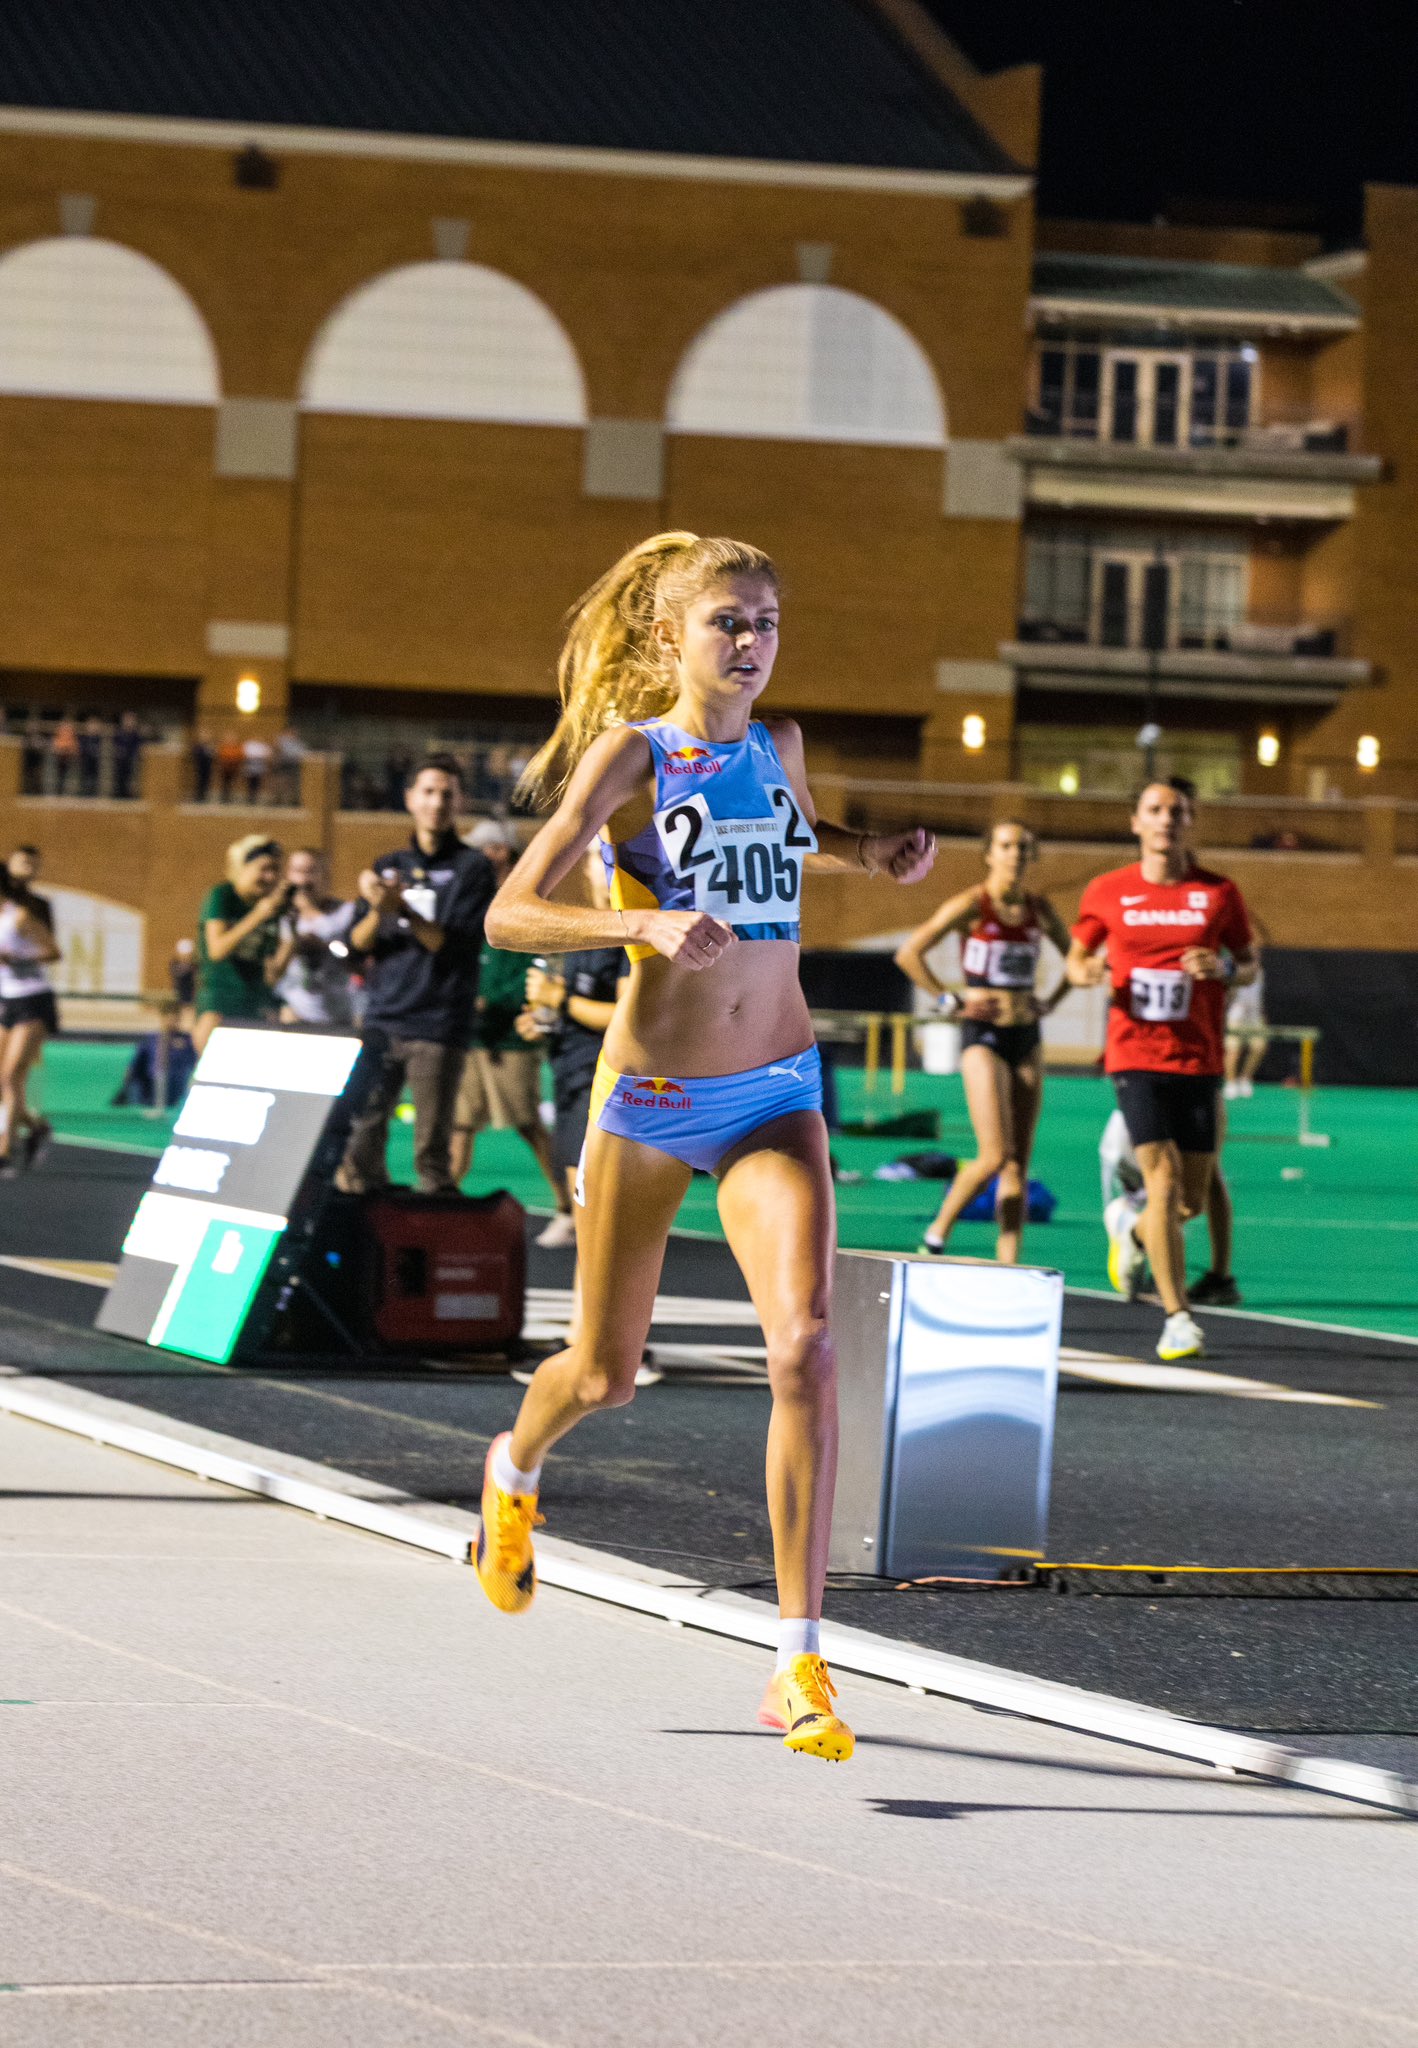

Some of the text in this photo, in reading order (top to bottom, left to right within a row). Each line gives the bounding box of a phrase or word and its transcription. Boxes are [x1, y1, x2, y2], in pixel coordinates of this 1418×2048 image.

[664, 760, 722, 775] Red Bull
[772, 788, 811, 847] 2
[664, 805, 716, 871] 2
[707, 842, 798, 904] 405
[1123, 909, 1206, 926] CANADA
[623, 1091, 692, 1110] Red Bull
